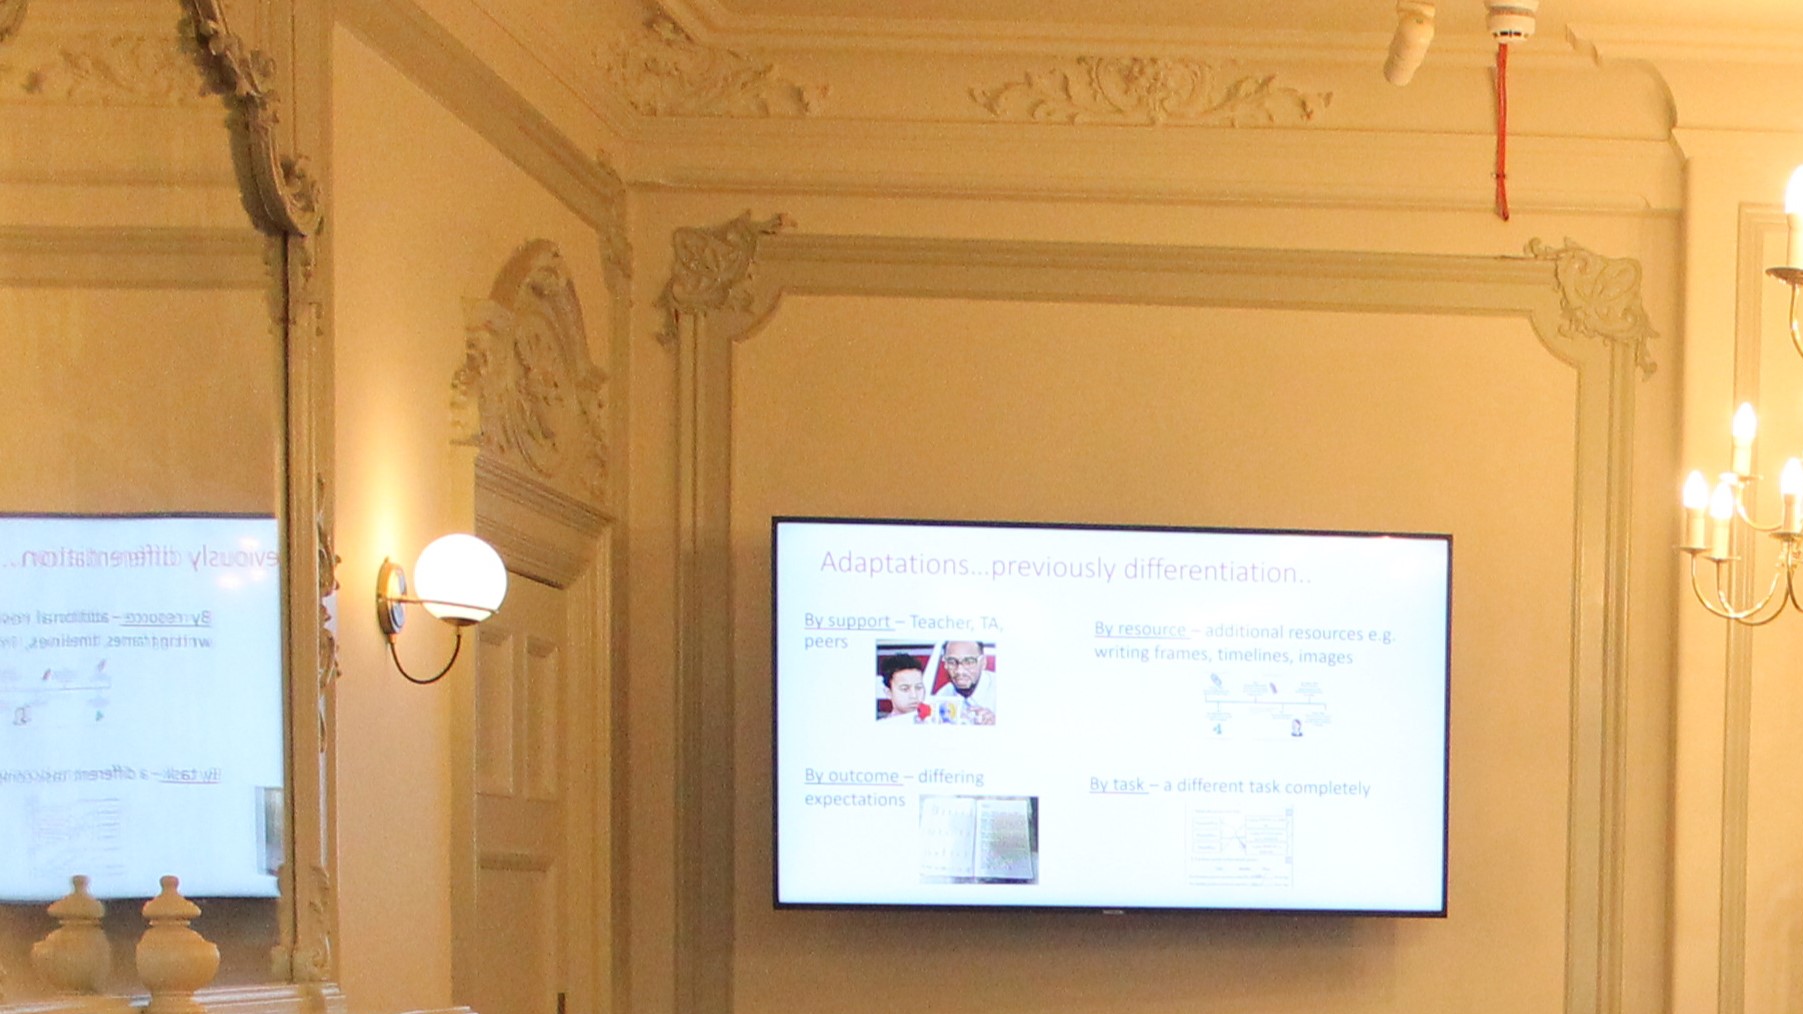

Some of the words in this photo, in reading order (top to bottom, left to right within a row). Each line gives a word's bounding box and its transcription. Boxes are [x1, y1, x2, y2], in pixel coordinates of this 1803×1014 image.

[820, 550, 1116, 583] Adaptations...previously
[1124, 557, 1312, 584] differentiation..
[805, 613, 823, 629] By
[828, 615, 890, 630] support
[910, 615, 974, 631] Teacher,
[979, 616, 1004, 632] TA,
[1095, 621, 1113, 637] By
[1118, 625, 1186, 637] resource
[1205, 624, 1283, 639] additional
[1288, 628, 1363, 641] resources
[1368, 630, 1396, 645] e.g.
[805, 636, 848, 650] peers
[1094, 646, 1149, 662] writing
[1154, 646, 1212, 663] frames,
[1218, 648, 1294, 664] timelines,
[1299, 650, 1353, 666] images
[805, 768, 824, 784] By
[828, 771, 899, 784] outcome
[918, 768, 984, 787] differing
[1090, 777, 1108, 793] By
[1114, 777, 1144, 791] task
[1164, 781, 1172, 792] a
[1177, 778, 1243, 793] different
[1249, 779, 1280, 794] task
[1285, 780, 1371, 798] completely
[805, 792, 906, 808] expectations
